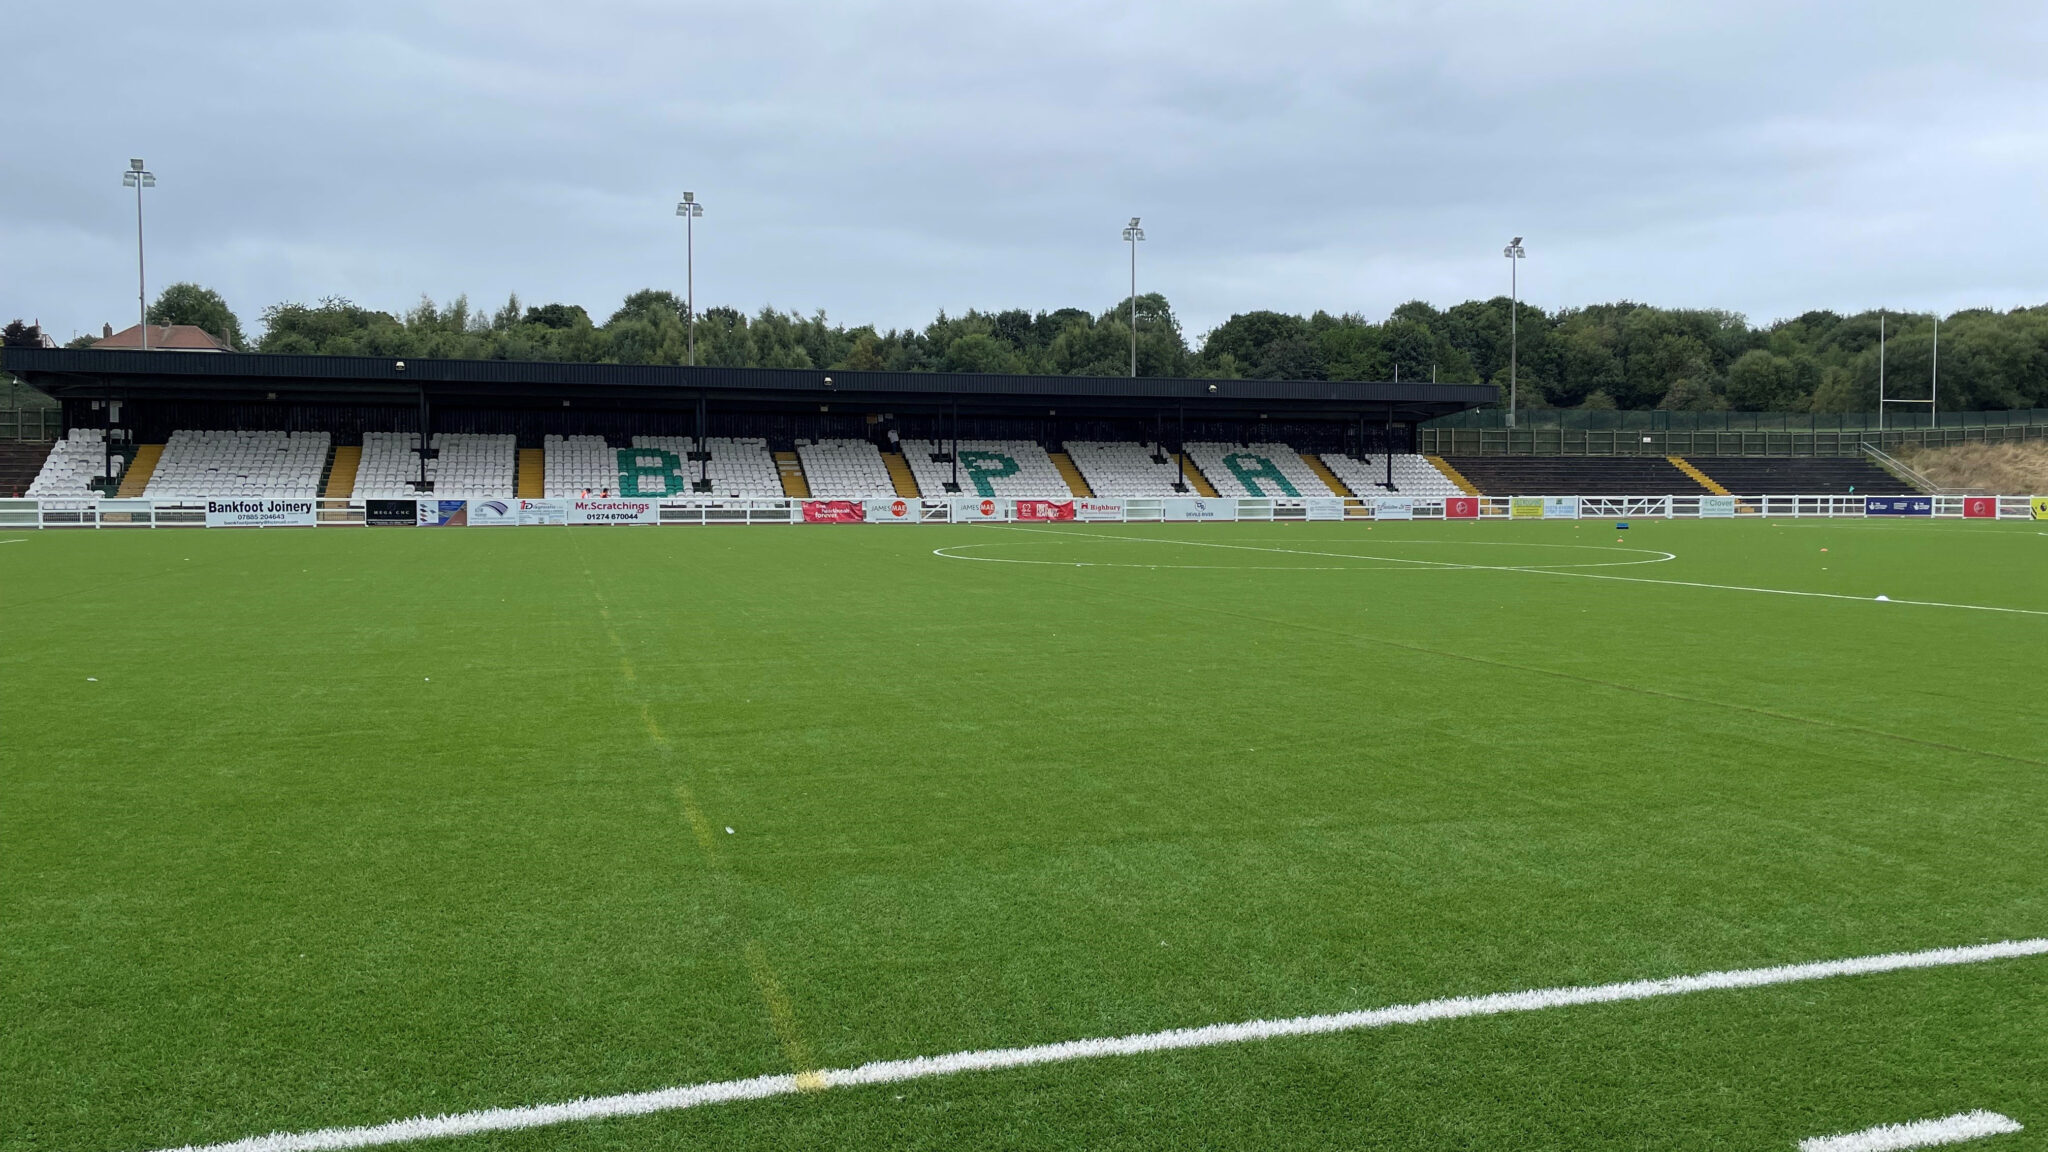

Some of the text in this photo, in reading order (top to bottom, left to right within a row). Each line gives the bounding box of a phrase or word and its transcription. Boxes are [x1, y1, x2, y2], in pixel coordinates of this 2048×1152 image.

[618, 448, 1302, 498] B P A
[208, 500, 312, 514] Bankfoot Joinery
[1090, 504, 1121, 512] Highbury
[1709, 499, 1733, 507] Clover
